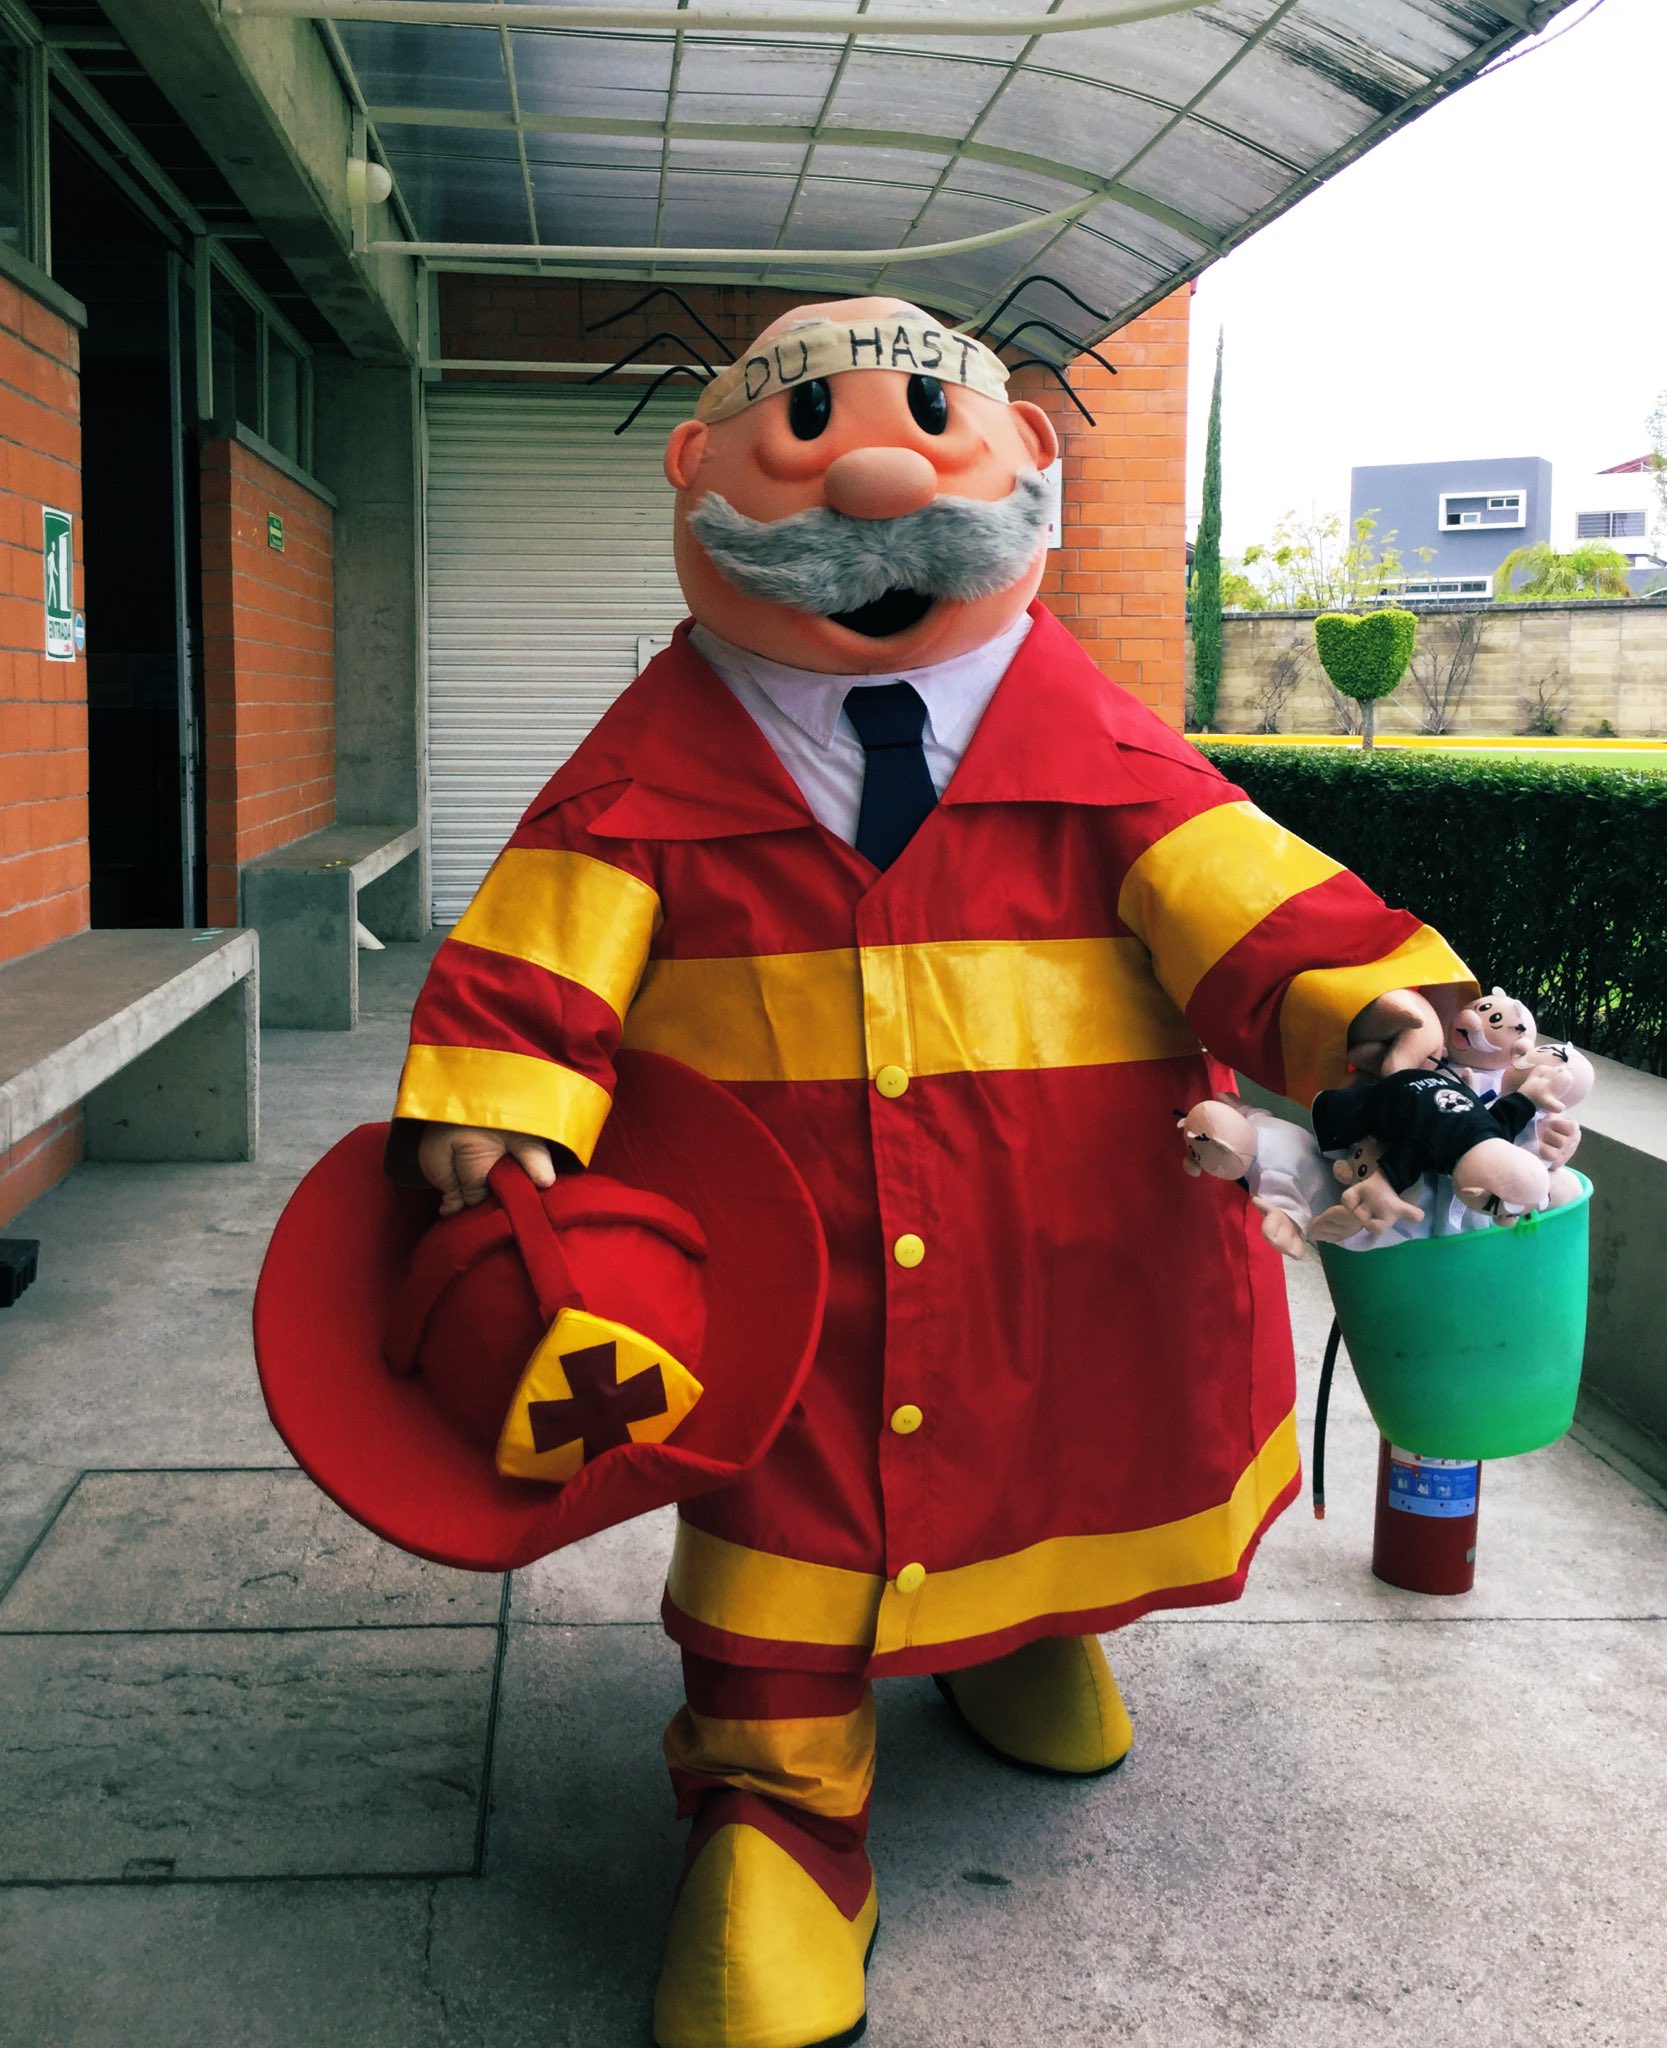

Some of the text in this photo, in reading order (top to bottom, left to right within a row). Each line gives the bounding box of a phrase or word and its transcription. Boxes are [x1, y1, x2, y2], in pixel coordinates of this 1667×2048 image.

[744, 325, 979, 401] DU HAST
[48, 620, 71, 640] ENTRADA
